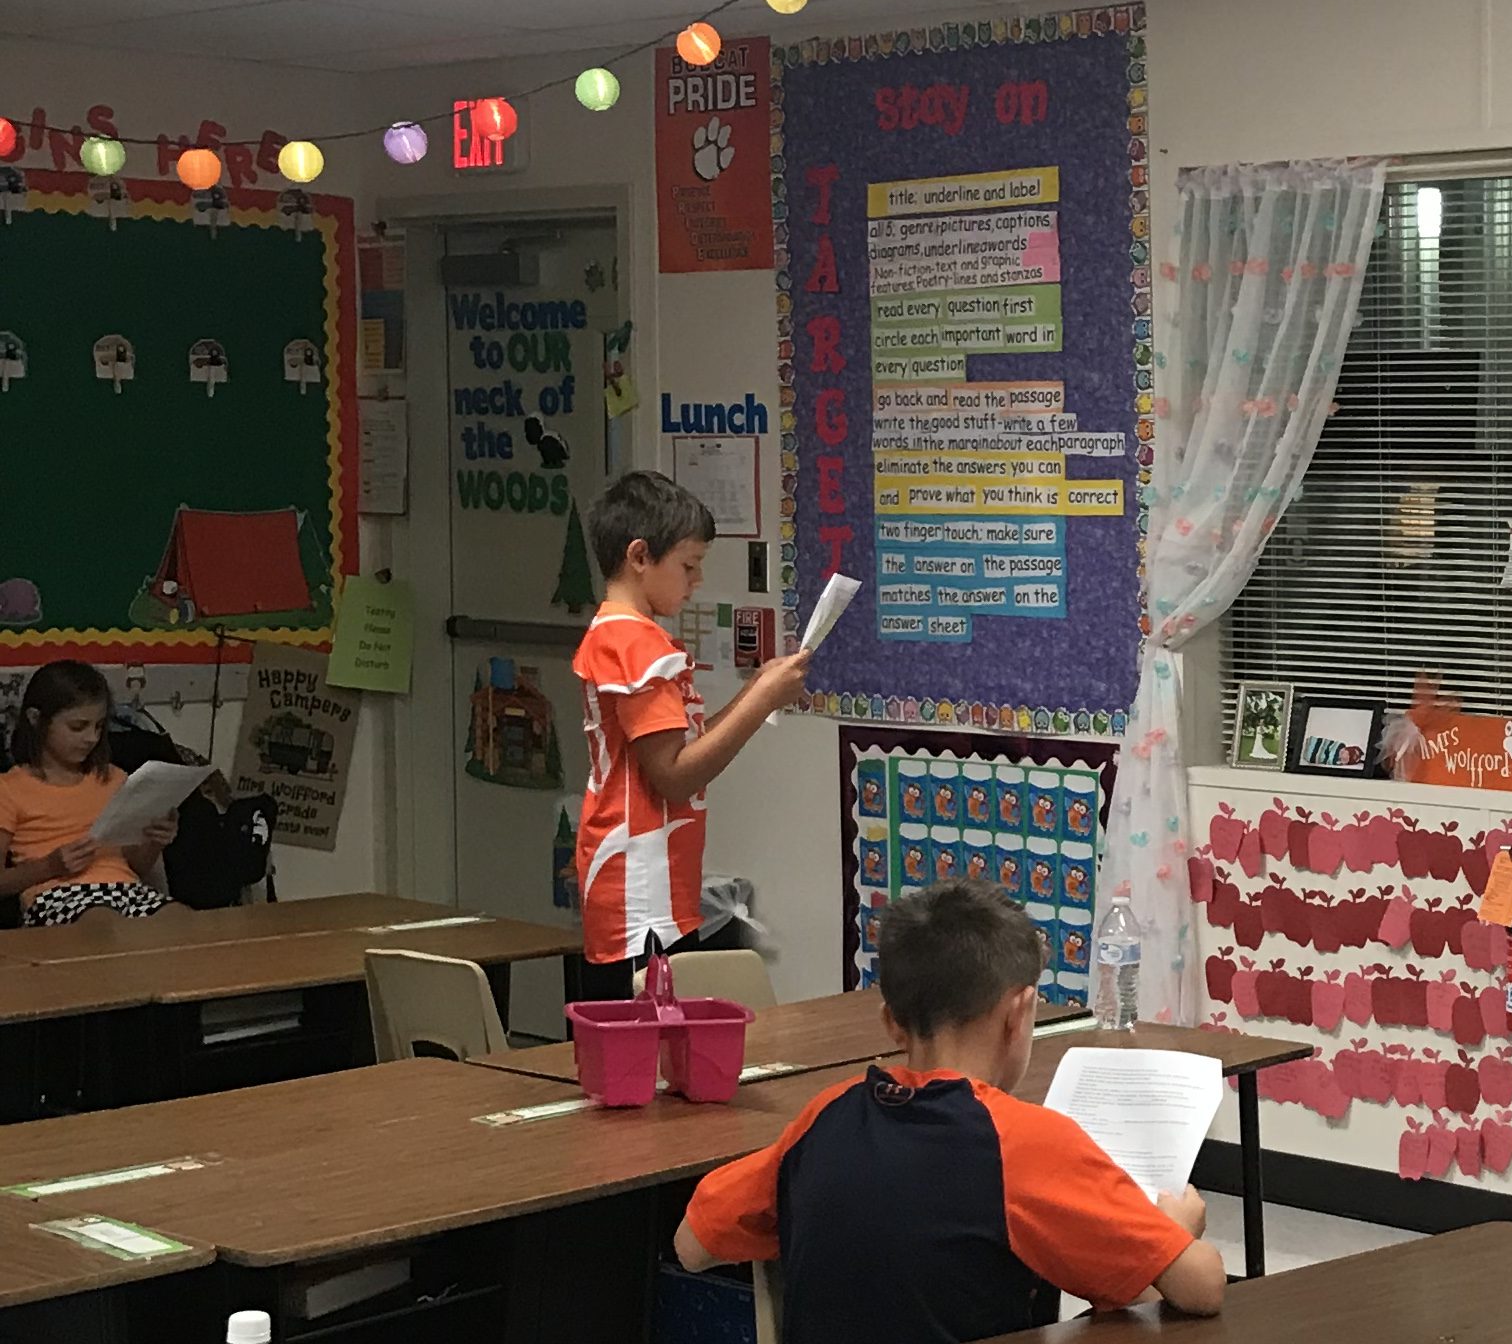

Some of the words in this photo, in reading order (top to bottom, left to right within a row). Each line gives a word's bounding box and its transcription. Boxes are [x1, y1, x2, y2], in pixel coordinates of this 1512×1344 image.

[672, 46, 748, 75] BCAT
[669, 72, 756, 114] PRIDE
[875, 83, 970, 135] stay
[995, 79, 1049, 125] on
[0, 103, 121, 170] INS
[924, 185, 981, 205] underline
[984, 182, 1007, 201] and
[1010, 178, 1042, 199] label
[1001, 267, 1043, 284] stanzas
[450, 292, 588, 332] Welcome
[878, 299, 904, 318] read
[908, 303, 941, 321] every
[947, 298, 1000, 316] question
[1002, 298, 1034, 315] first
[875, 330, 908, 348] circle
[911, 329, 939, 346] each
[941, 327, 1001, 347] important
[1006, 326, 1038, 344] word
[469, 334, 506, 370] to
[506, 331, 572, 373] OUR
[875, 361, 909, 379] every
[911, 358, 964, 375] question
[454, 381, 525, 417] neck
[539, 376, 576, 414] of
[878, 393, 892, 411] go
[895, 391, 924, 406] back
[926, 390, 949, 406] and
[952, 391, 982, 408] read
[984, 391, 1006, 407] the
[1009, 389, 1062, 408] passage
[661, 393, 769, 436] Lunch
[873, 414, 906, 431] write
[909, 414, 930, 431] the
[931, 414, 960, 433] good
[1049, 413, 1078, 432] few
[461, 422, 515, 459] the
[872, 436, 909, 450] words
[923, 435, 945, 451] the
[1026, 436, 1058, 452] each
[1058, 435, 1126, 455] paragraph
[876, 458, 931, 475] eliminate
[932, 457, 954, 474] the
[957, 460, 1007, 475] answers
[1010, 460, 1034, 478] you
[1039, 460, 1062, 475] can
[457, 469, 570, 514] WOODS
[880, 490, 900, 506] and
[909, 488, 943, 504] prove
[946, 486, 976, 505] what
[983, 488, 1005, 505] you
[1008, 486, 1042, 505] think
[1068, 489, 1119, 505] correct
[881, 522, 901, 534] two
[904, 521, 942, 542] finger
[987, 525, 1019, 542] make
[1024, 527, 1055, 542] sure
[885, 557, 906, 573] the
[915, 560, 957, 574] answer
[960, 562, 975, 574] on
[984, 557, 1006, 572] the
[1010, 557, 1063, 576] passage
[881, 587, 931, 603] matches
[938, 588, 960, 604] the
[962, 589, 1006, 604] answer
[1014, 591, 1031, 604] on
[1034, 587, 1059, 604] the
[736, 611, 761, 625] FIRE
[881, 616, 923, 631] answer
[930, 618, 967, 635] sheet
[257, 668, 319, 694] Happy
[269, 689, 353, 723] Campers
[1422, 726, 1460, 760] Mrs
